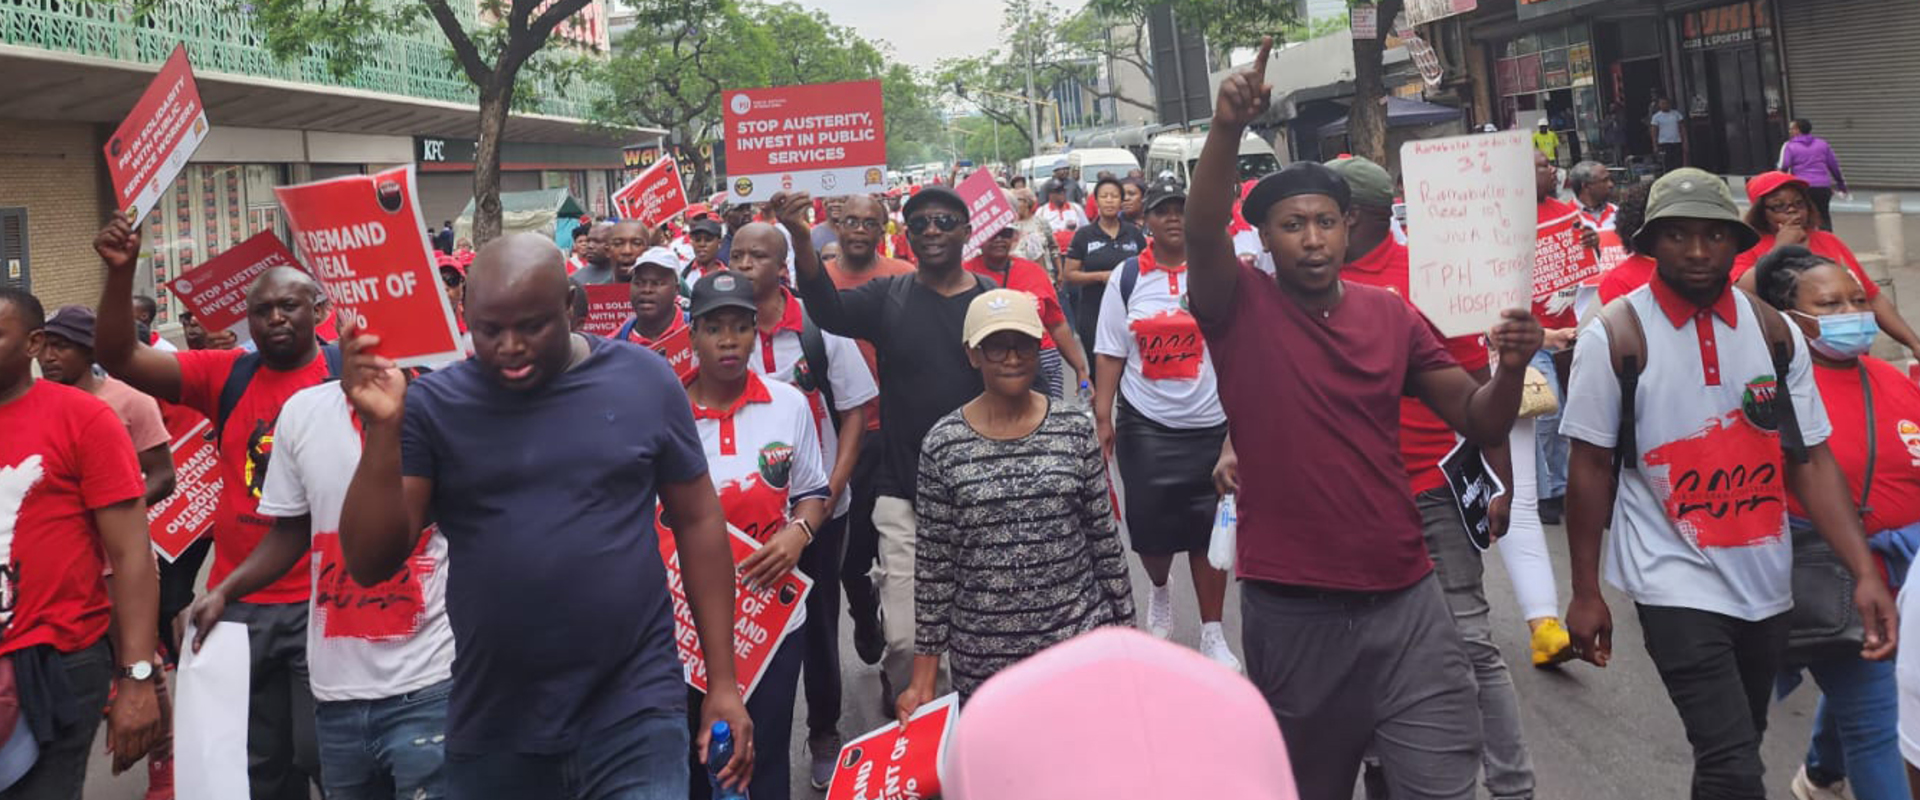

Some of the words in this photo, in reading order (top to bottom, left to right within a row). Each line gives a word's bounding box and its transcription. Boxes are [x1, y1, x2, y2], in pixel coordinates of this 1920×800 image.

[140, 74, 185, 139] SOLIDARITY
[131, 139, 154, 170] WITH
[153, 101, 181, 142] PUBLIC
[737, 119, 779, 134] STOP
[783, 112, 873, 132] AUSTERITY,
[123, 153, 158, 198] SERVICE
[157, 101, 195, 155] WORKERS
[424, 139, 445, 161] KFC
[737, 134, 794, 151] INVEST
[797, 133, 814, 146] IN
[818, 128, 875, 144] PUBLIC
[768, 147, 845, 165] SERVICES
[307, 221, 387, 252] DEMAND
[191, 285, 221, 306] STOP
[223, 252, 285, 290] AUSTERITY,
[315, 254, 356, 280] REAL
[1419, 257, 1472, 289] TPH
[385, 271, 417, 298] OF
[200, 290, 241, 316] INVEST
[590, 312, 615, 321] WITH
[668, 347, 691, 366] WE
[185, 479, 210, 501] ALL
[741, 596, 765, 618] OF
[734, 616, 769, 645] AND
[891, 737, 910, 761] OF
